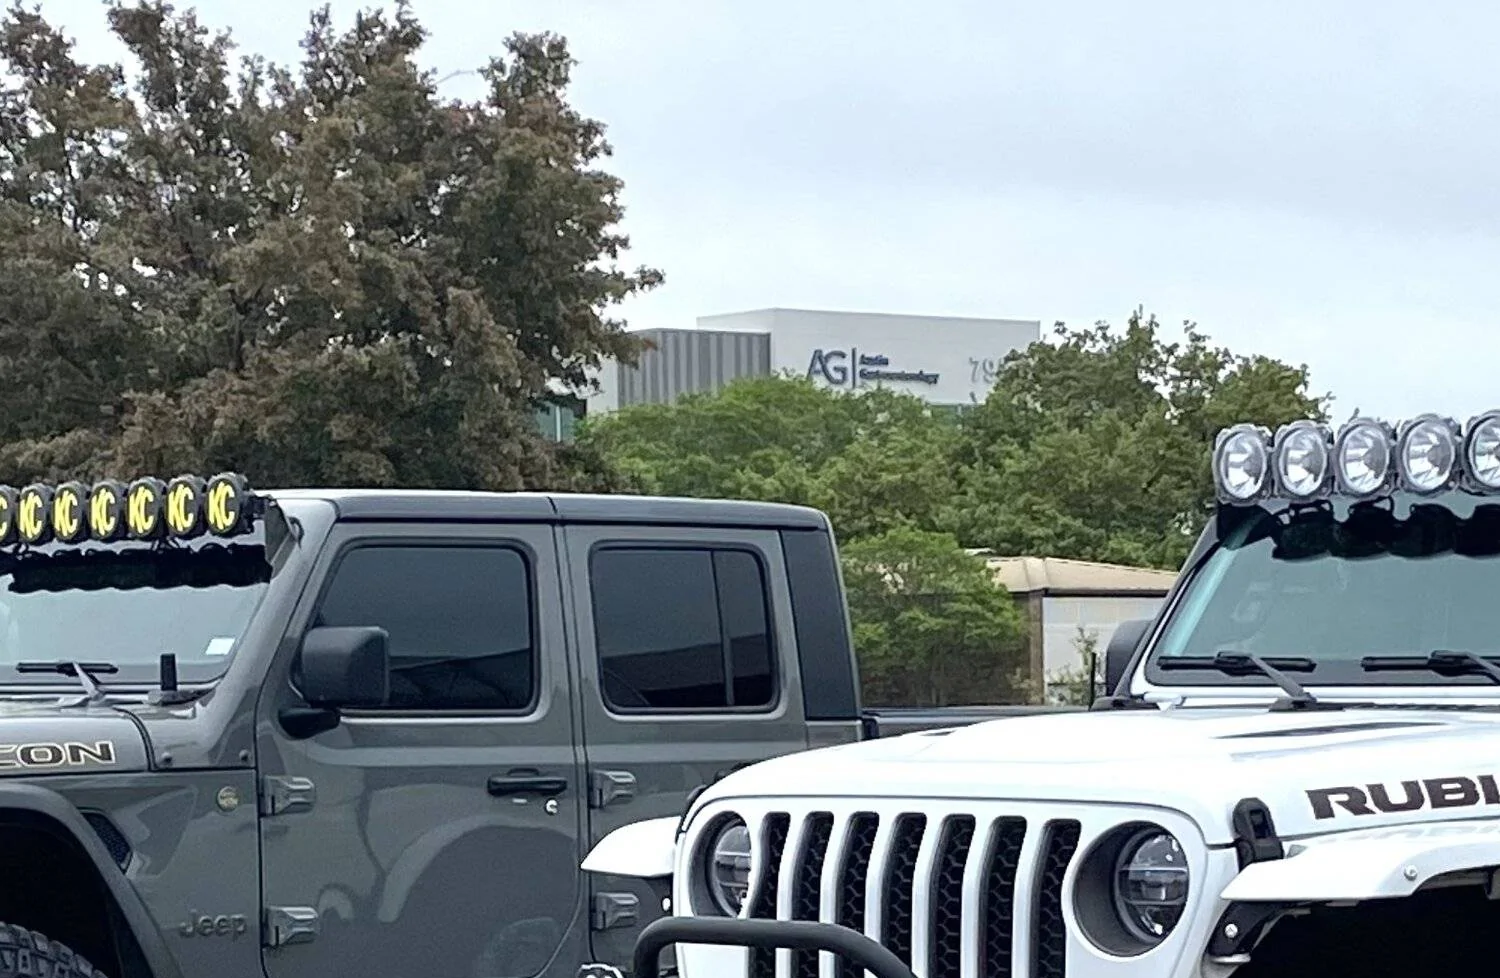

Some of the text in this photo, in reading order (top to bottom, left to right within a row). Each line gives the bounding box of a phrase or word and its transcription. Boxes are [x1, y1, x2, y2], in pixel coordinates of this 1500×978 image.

[807, 349, 848, 385] AG
[20, 492, 43, 539] KC
[55, 490, 78, 537] KC
[91, 488, 116, 536] KC
[129, 486, 154, 534] KC
[168, 484, 194, 532] KC
[208, 481, 235, 530] KC
[179, 908, 248, 943] Jeep
